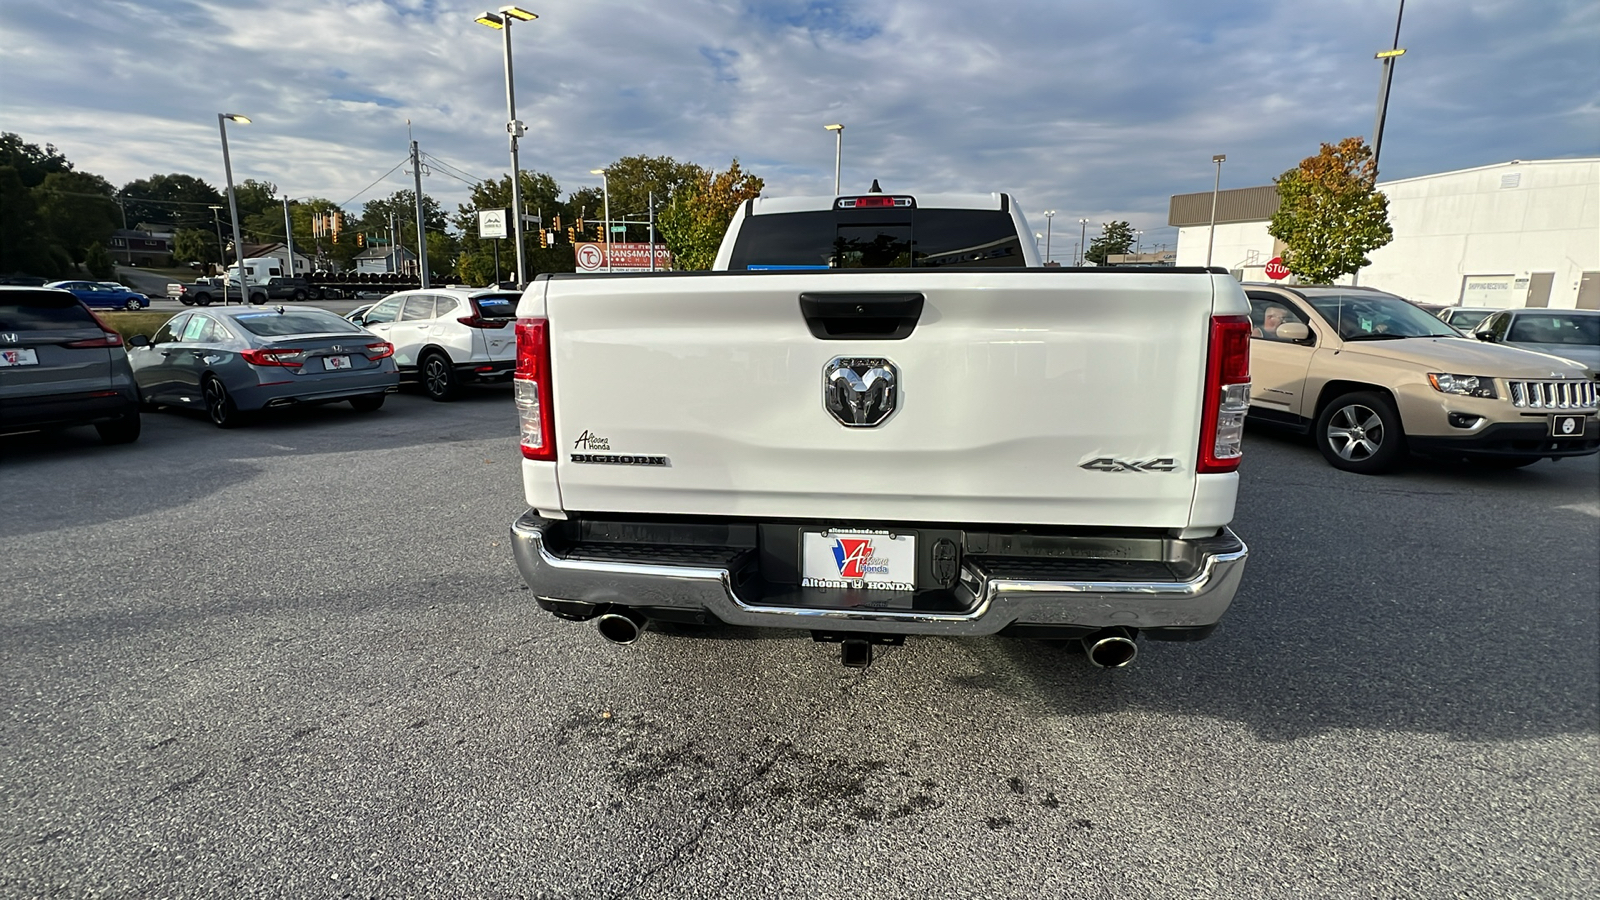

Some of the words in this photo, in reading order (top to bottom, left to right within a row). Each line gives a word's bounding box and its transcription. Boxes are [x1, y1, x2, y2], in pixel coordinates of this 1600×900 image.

[574, 429, 608, 449] Altoona
[588, 442, 610, 450] Honda
[570, 454, 666, 465] BIGHORN
[841, 542, 889, 574] Altoona
[860, 565, 888, 573] Honda
[801, 578, 848, 587] Altoona
[867, 581, 915, 591] HONDA
